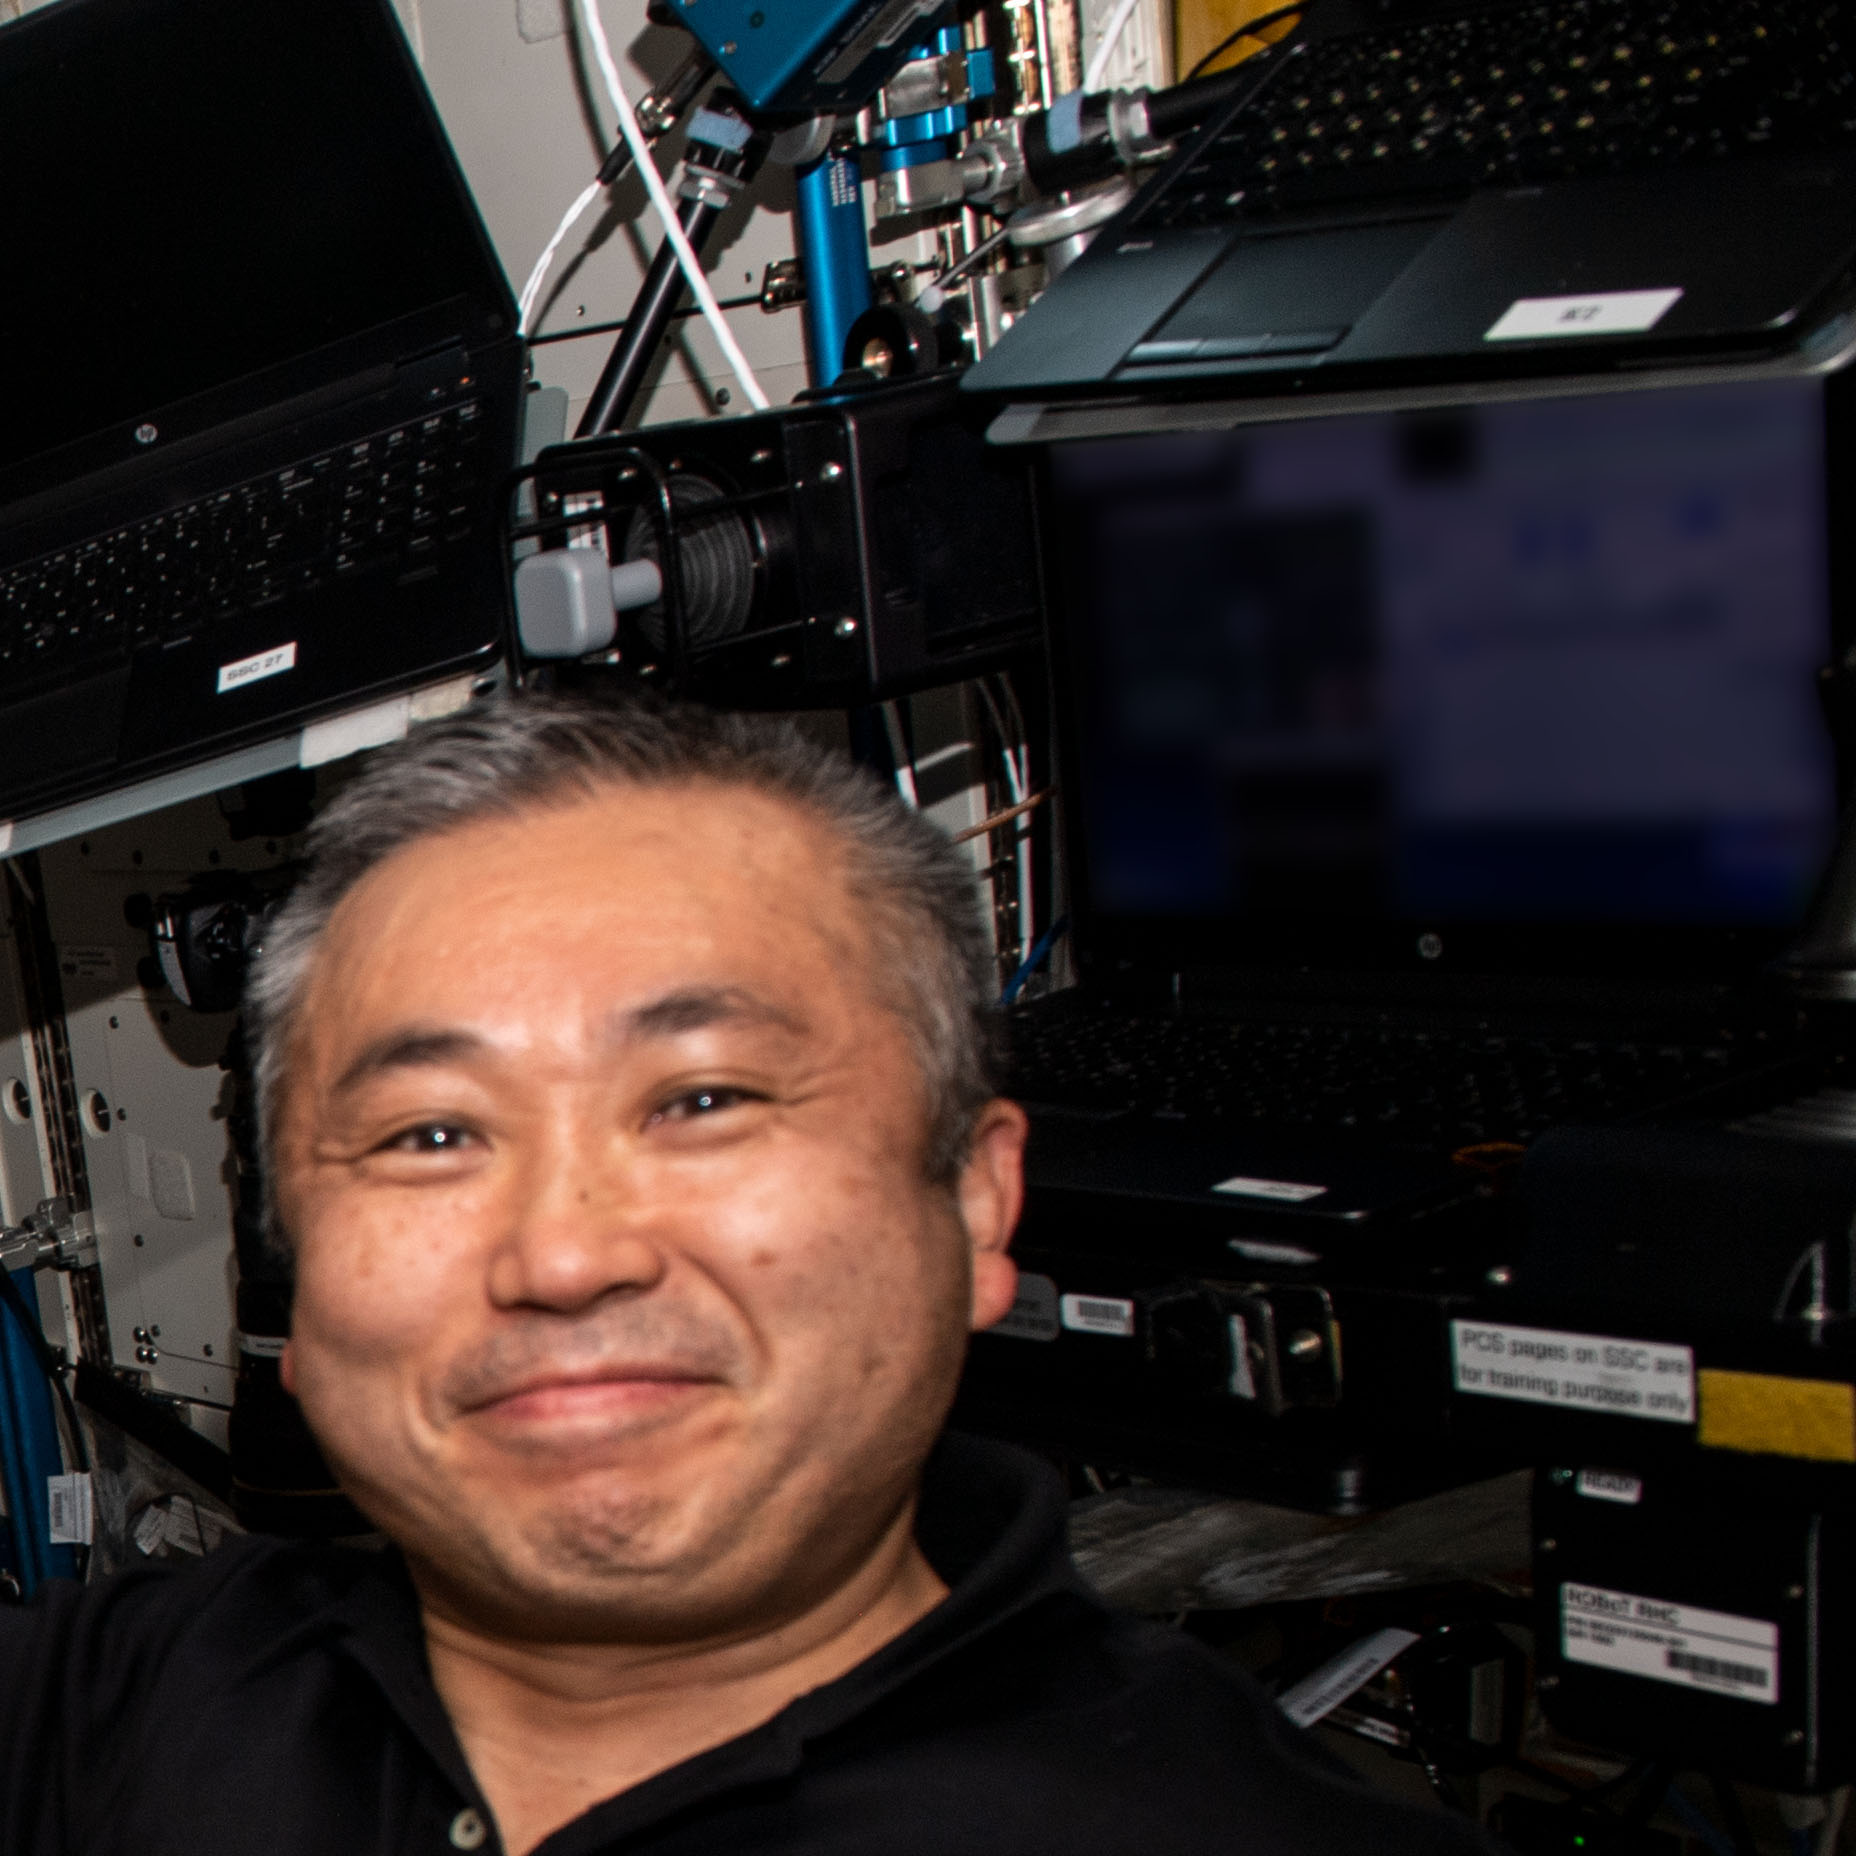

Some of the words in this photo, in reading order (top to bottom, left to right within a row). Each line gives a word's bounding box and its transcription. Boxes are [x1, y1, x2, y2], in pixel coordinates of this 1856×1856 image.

[1510, 1339, 1568, 1363] pages
[1488, 1369, 1558, 1402] training
[1646, 1391, 1690, 1414] only
